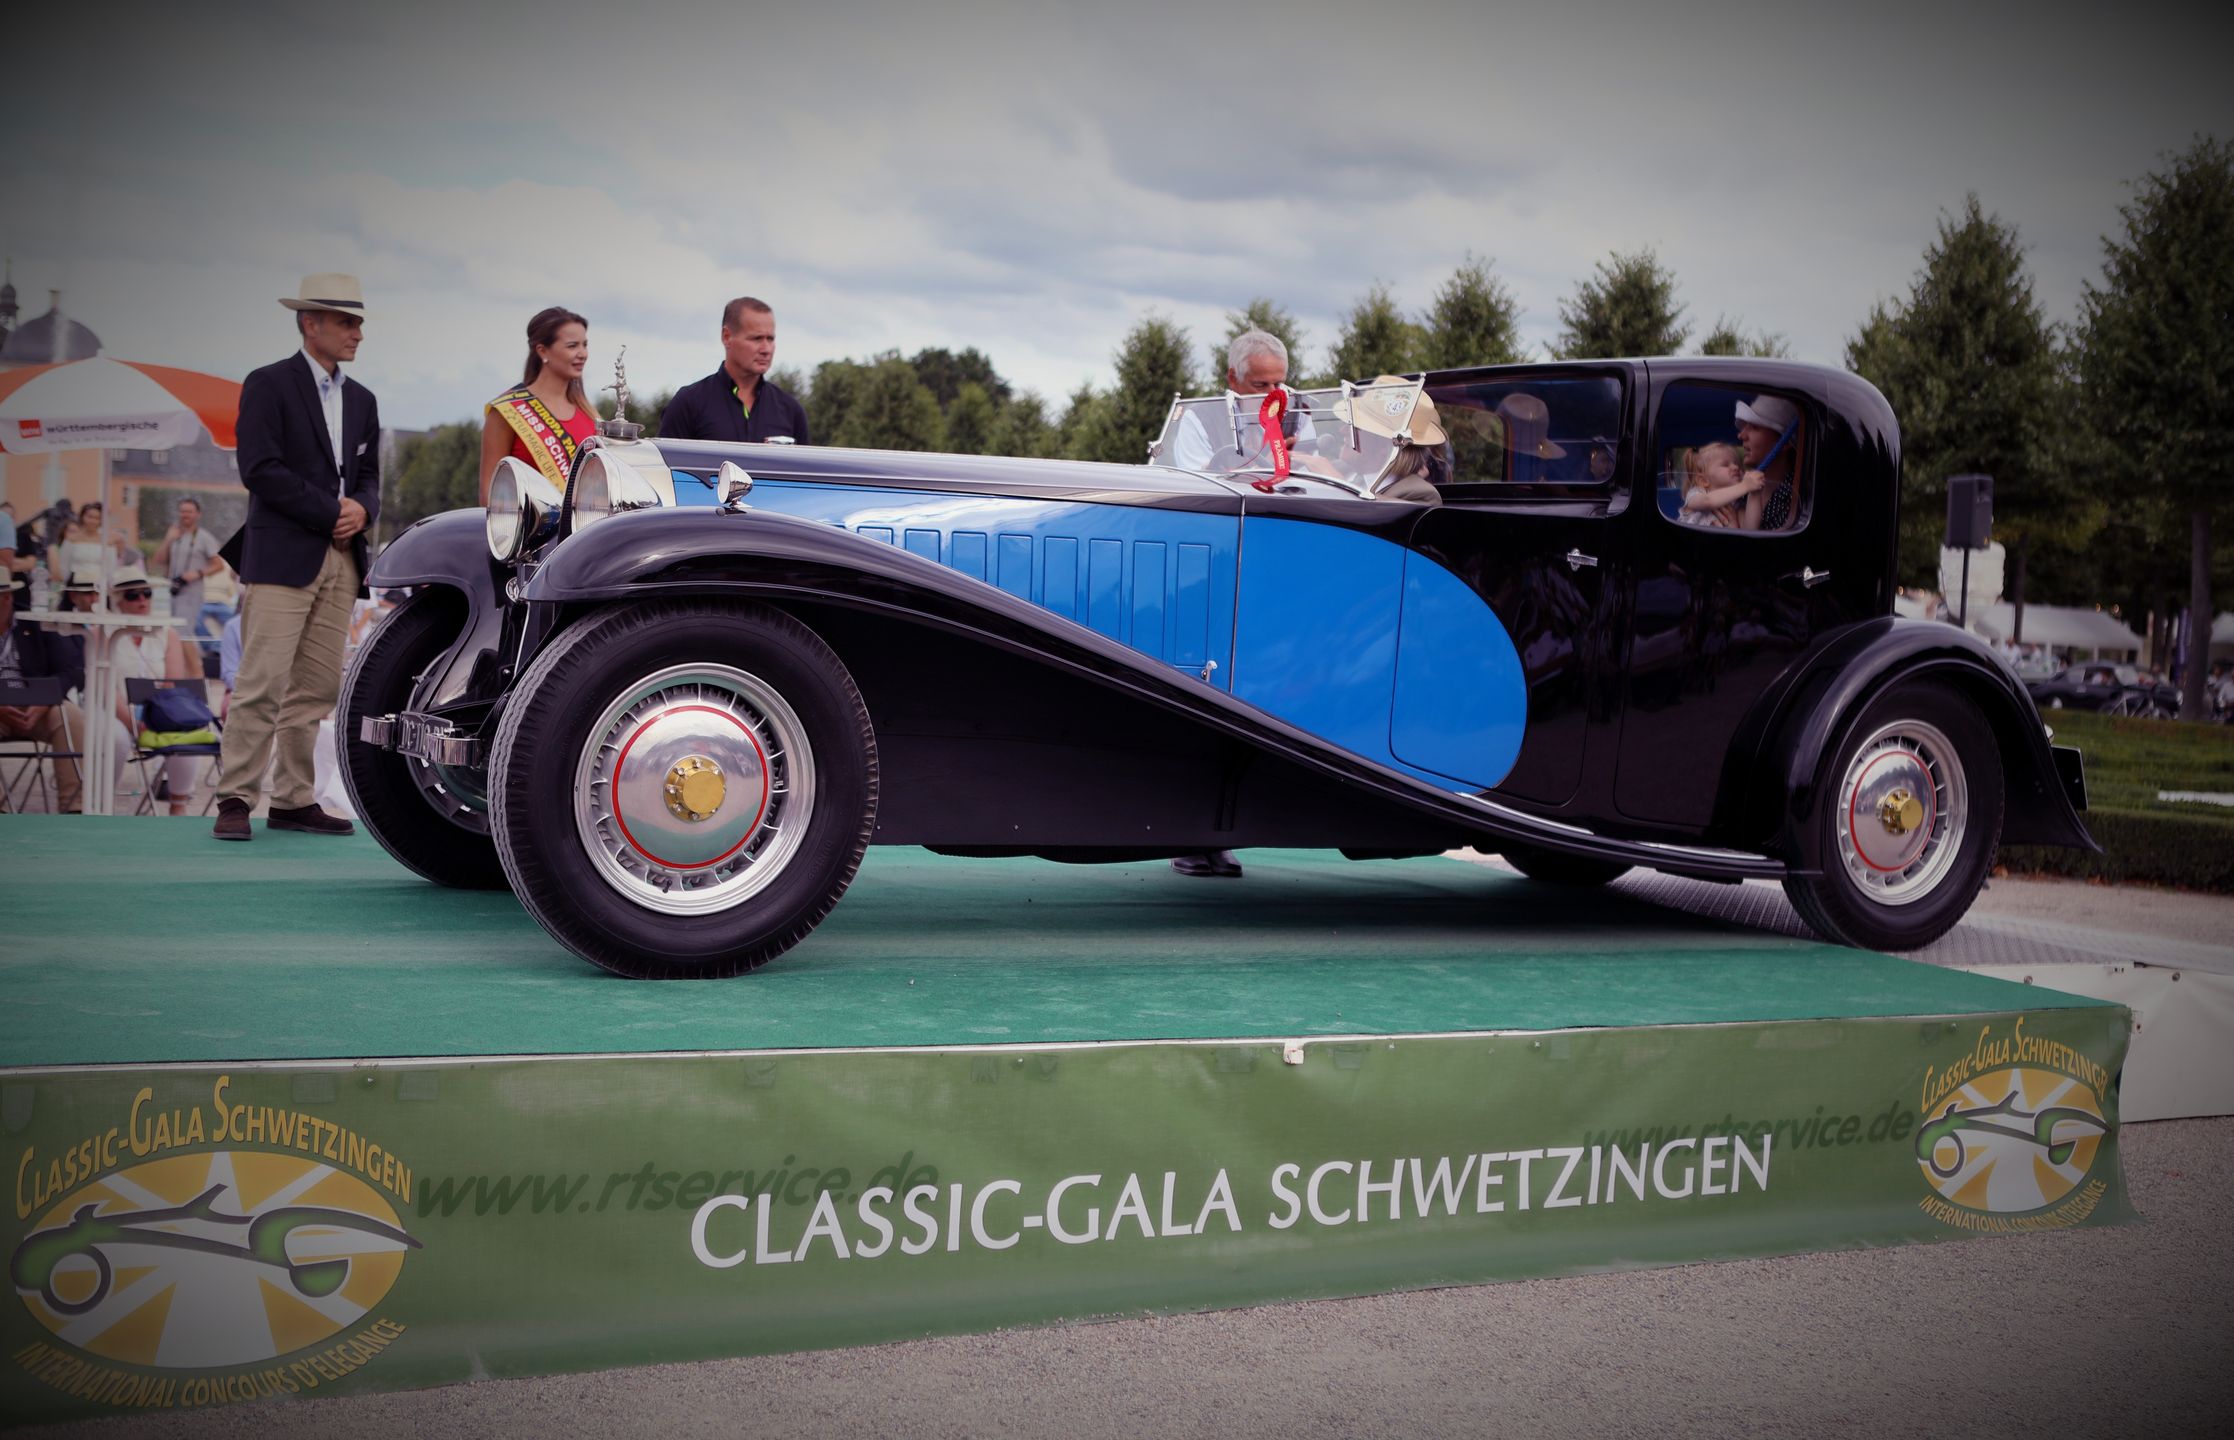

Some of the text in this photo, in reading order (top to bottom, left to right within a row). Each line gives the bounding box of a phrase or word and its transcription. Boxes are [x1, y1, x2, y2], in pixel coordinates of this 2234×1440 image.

[46, 421, 159, 433] württembergische
[516, 403, 570, 480] MISS SCHW
[526, 433, 547, 461] MAGIC
[542, 461, 557, 480] LIFE
[528, 399, 577, 461] EUROPA PA
[417, 1150, 939, 1218] www.rtservice.de
[1268, 1133, 1772, 1229] SCHWETZINGEN
[14, 1317, 407, 1408] INTERNATIONAL CONCOURS D'ELEGANCE
